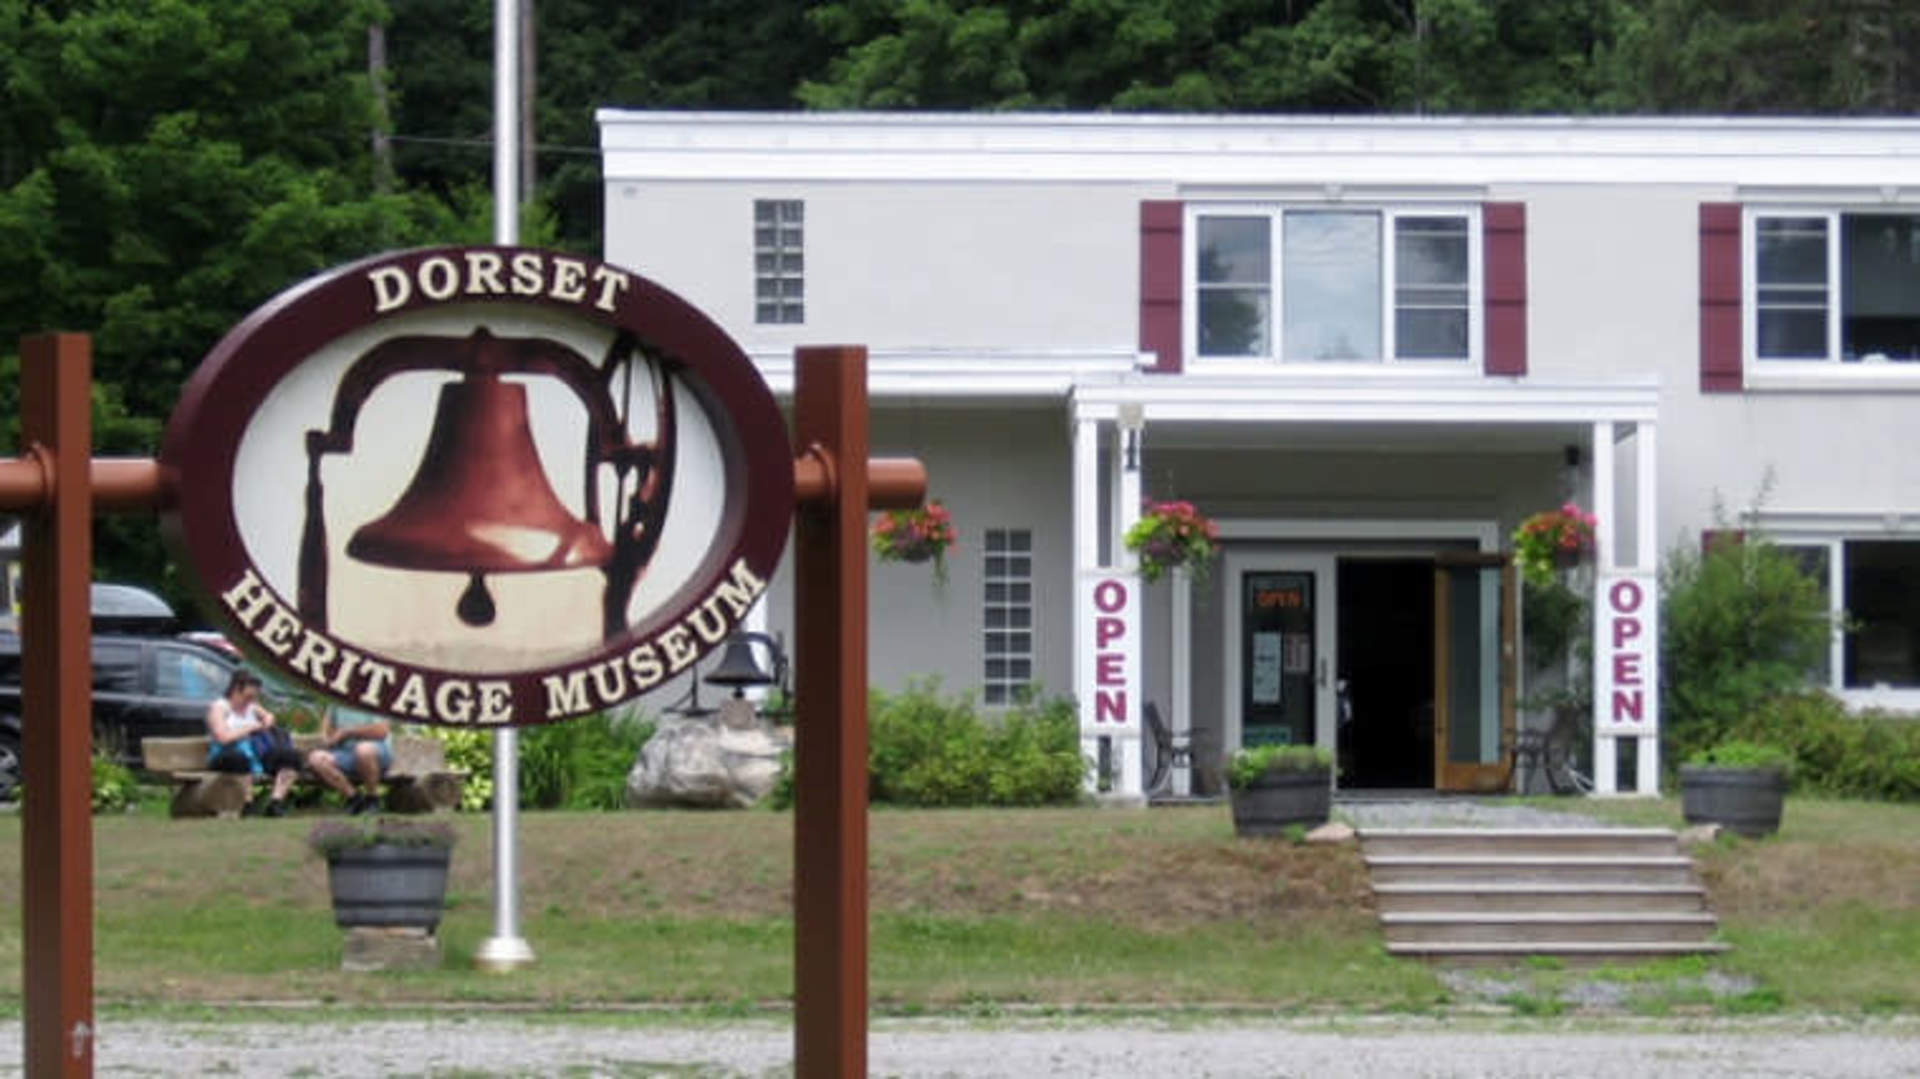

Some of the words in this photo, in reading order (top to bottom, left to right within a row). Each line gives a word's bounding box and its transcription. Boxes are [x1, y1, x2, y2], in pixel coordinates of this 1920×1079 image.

[370, 252, 628, 312] DORSET
[223, 571, 512, 724] HERITAGE
[545, 559, 766, 719] MUSEUM
[1094, 580, 1127, 722] OPEN
[1609, 580, 1643, 722] OPEN
